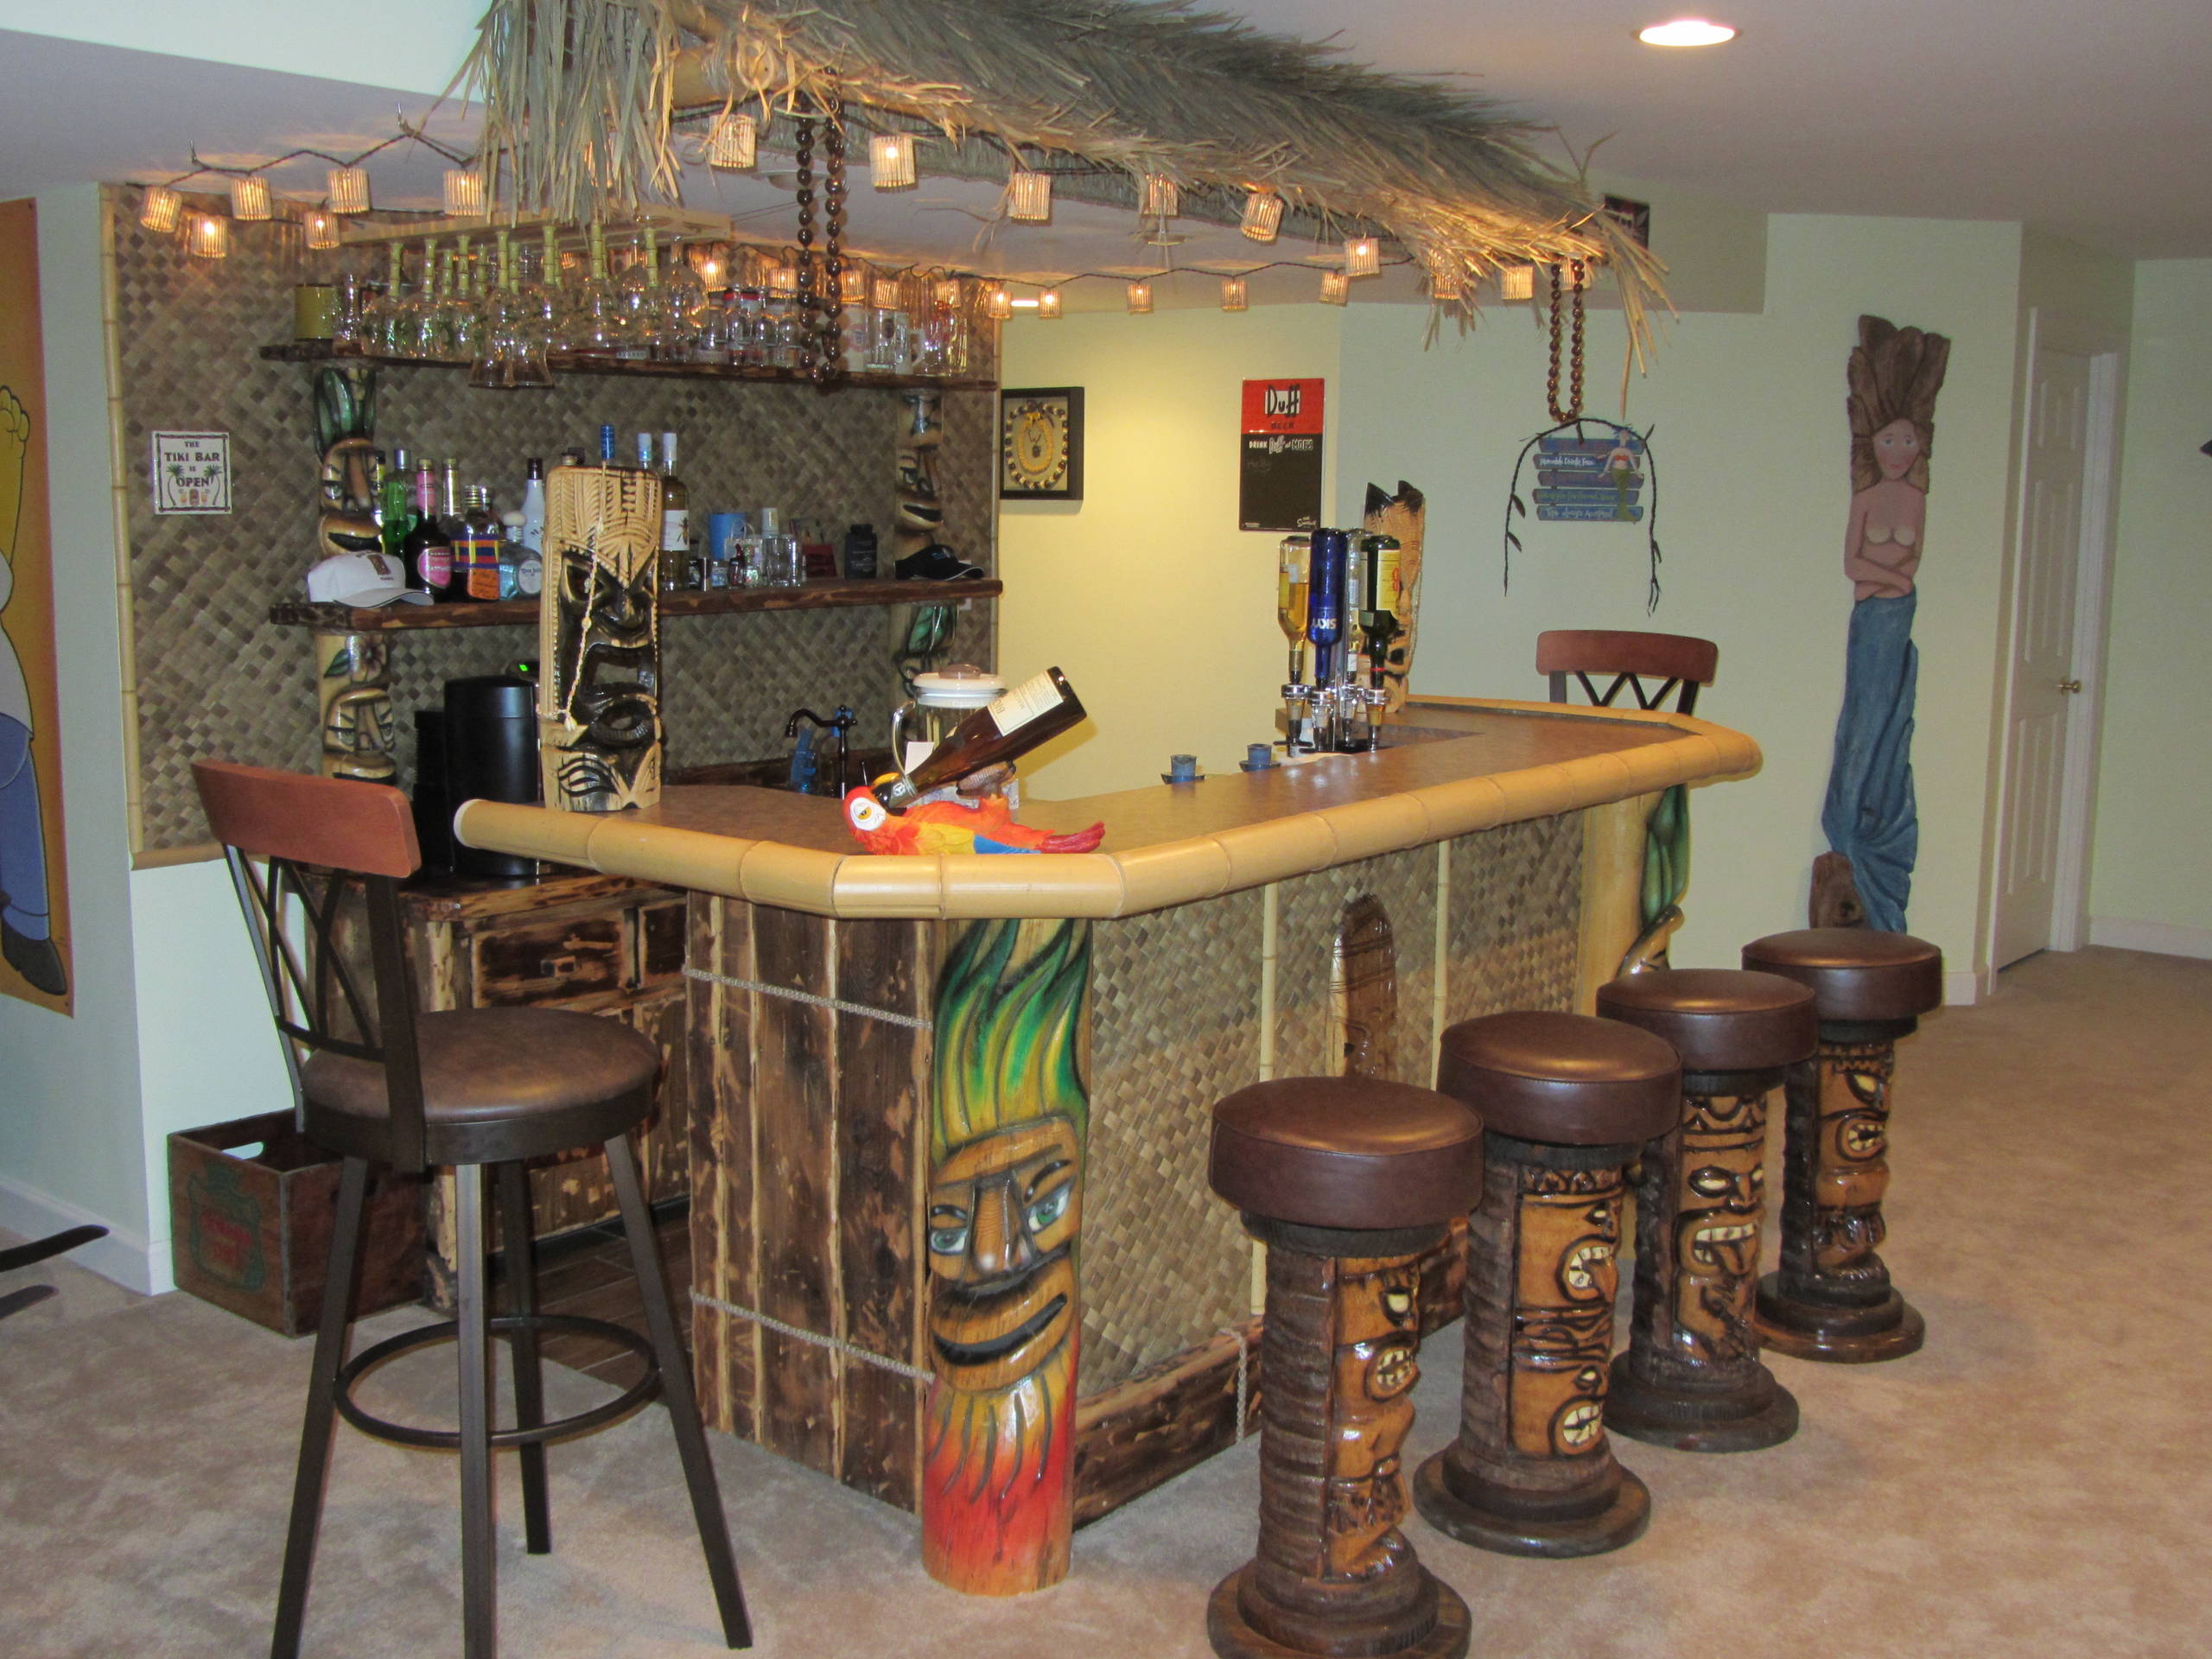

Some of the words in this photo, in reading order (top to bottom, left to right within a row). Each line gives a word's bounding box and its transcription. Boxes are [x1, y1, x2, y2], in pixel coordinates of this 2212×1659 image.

[1267, 384, 1300, 417] Duff
[164, 452, 189, 461] TIKI
[194, 452, 219, 461] BAR
[176, 478, 209, 486] OPEN
[1311, 618, 1338, 629] SKYY
